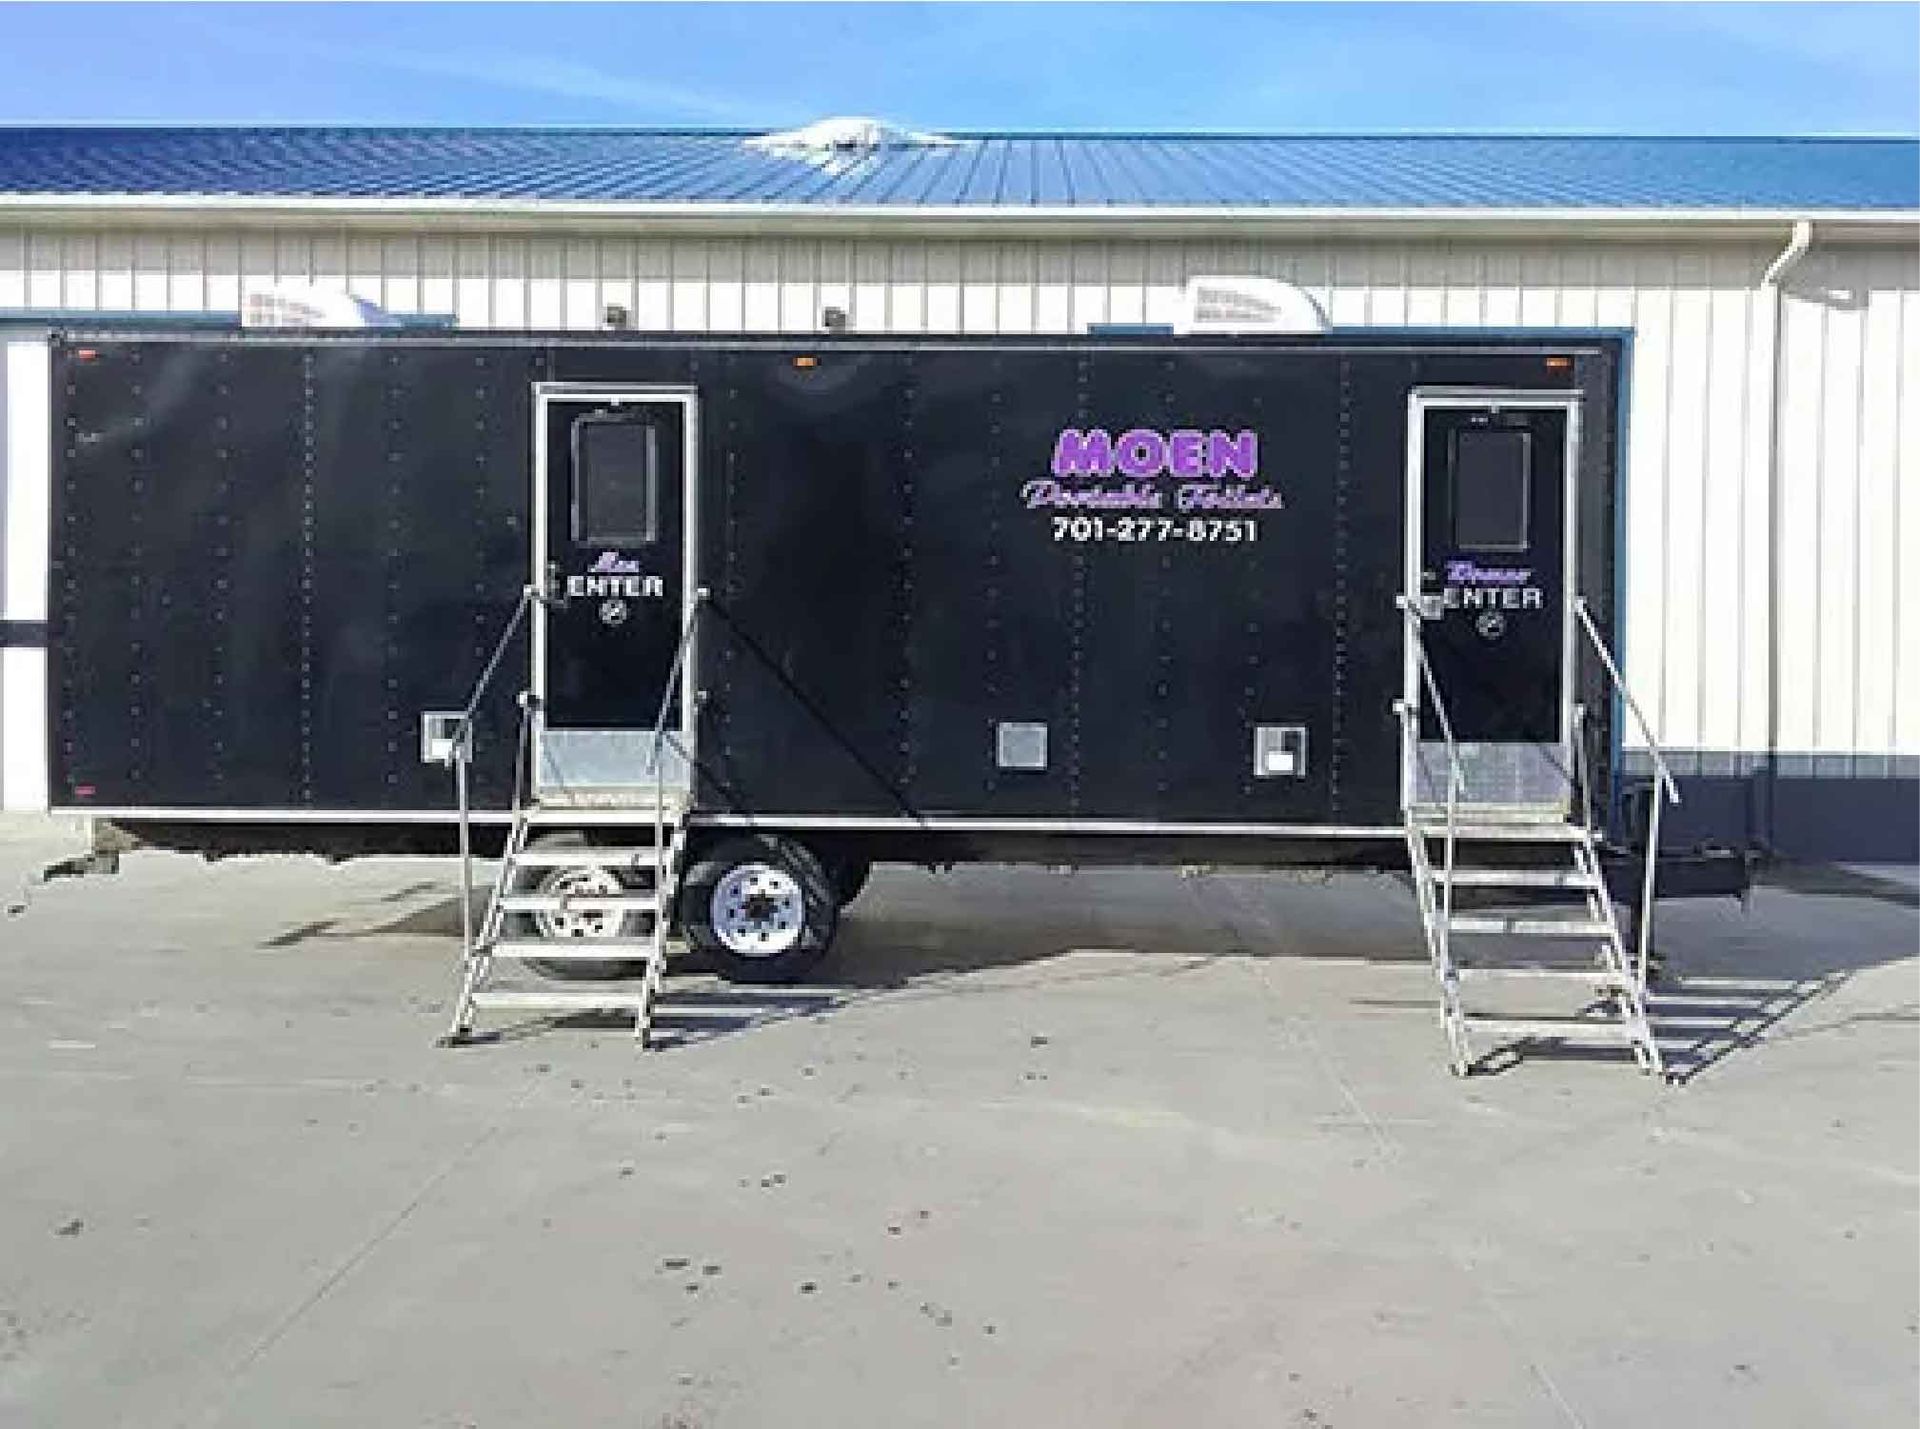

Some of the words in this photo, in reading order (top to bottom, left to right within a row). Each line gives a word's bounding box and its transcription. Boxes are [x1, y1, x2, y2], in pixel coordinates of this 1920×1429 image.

[1053, 429, 1257, 477] MOEN
[1021, 481, 1162, 509] Portable
[1175, 484, 1284, 511] Toilets
[1053, 517, 1256, 541] 701-277-8751
[567, 576, 663, 596] ENTER
[1443, 588, 1543, 609] ENTER
